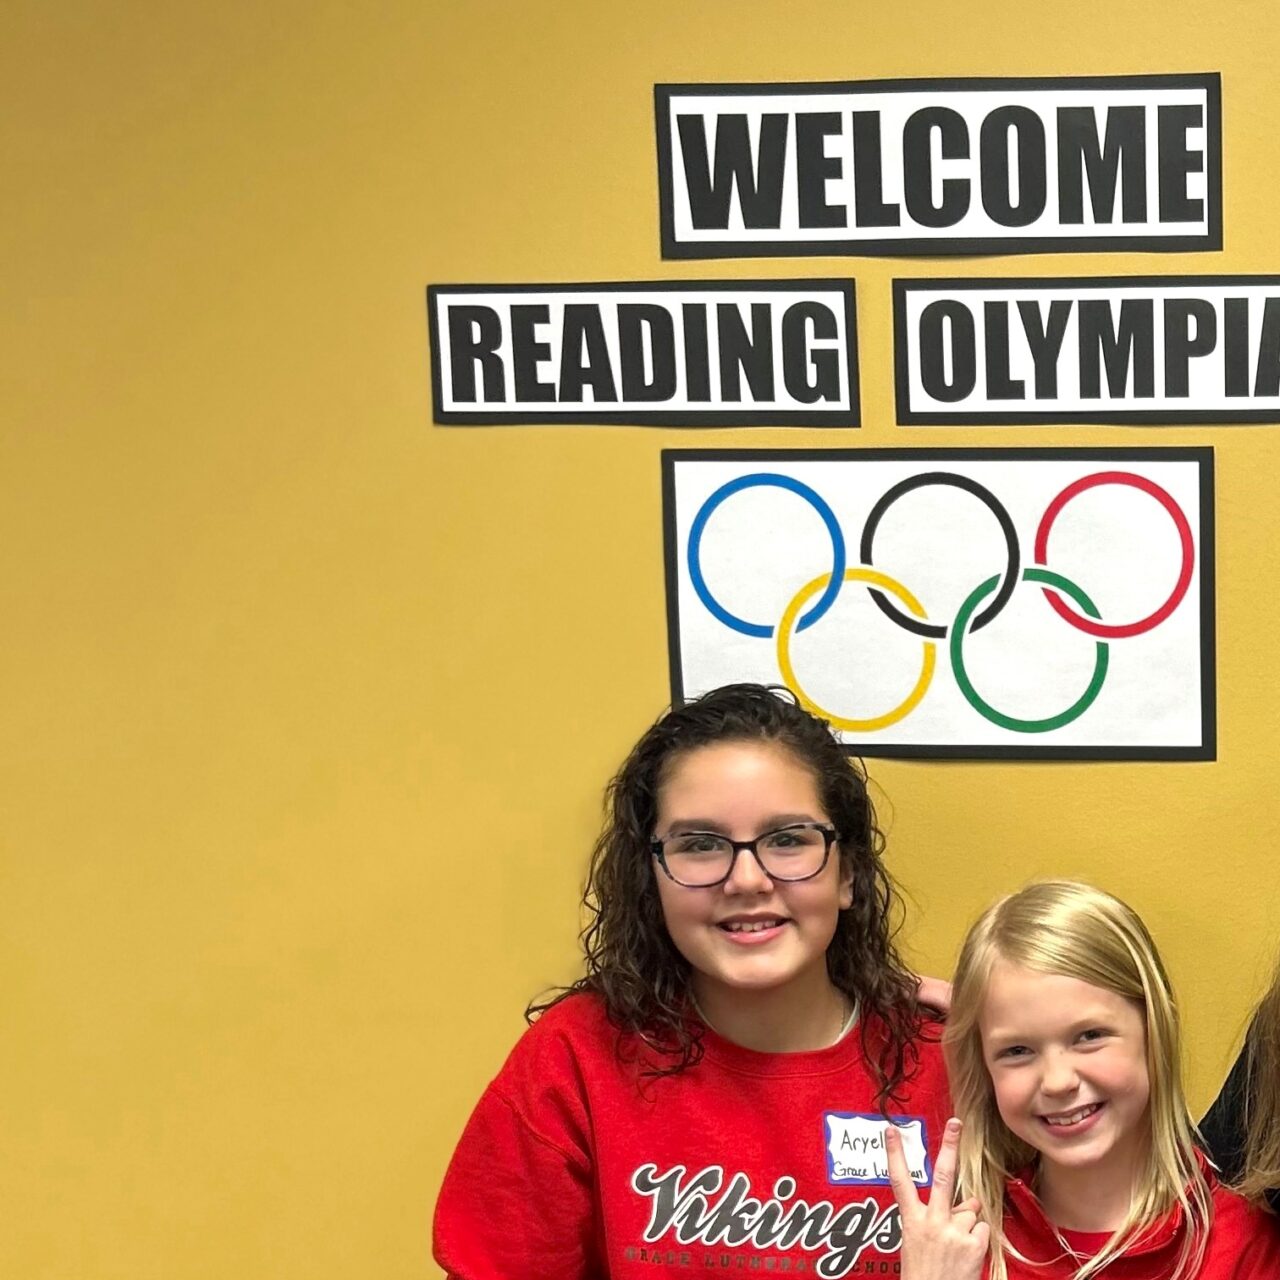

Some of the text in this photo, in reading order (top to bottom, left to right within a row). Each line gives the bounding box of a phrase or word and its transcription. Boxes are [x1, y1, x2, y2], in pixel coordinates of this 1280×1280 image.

[675, 103, 1206, 232] WELCOME
[447, 300, 843, 405] READING
[840, 1129, 885, 1154] Aryel
[873, 1162, 924, 1179] Luan
[632, 1163, 903, 1280] Vikings
[704, 1254, 818, 1273] LUTHERA
